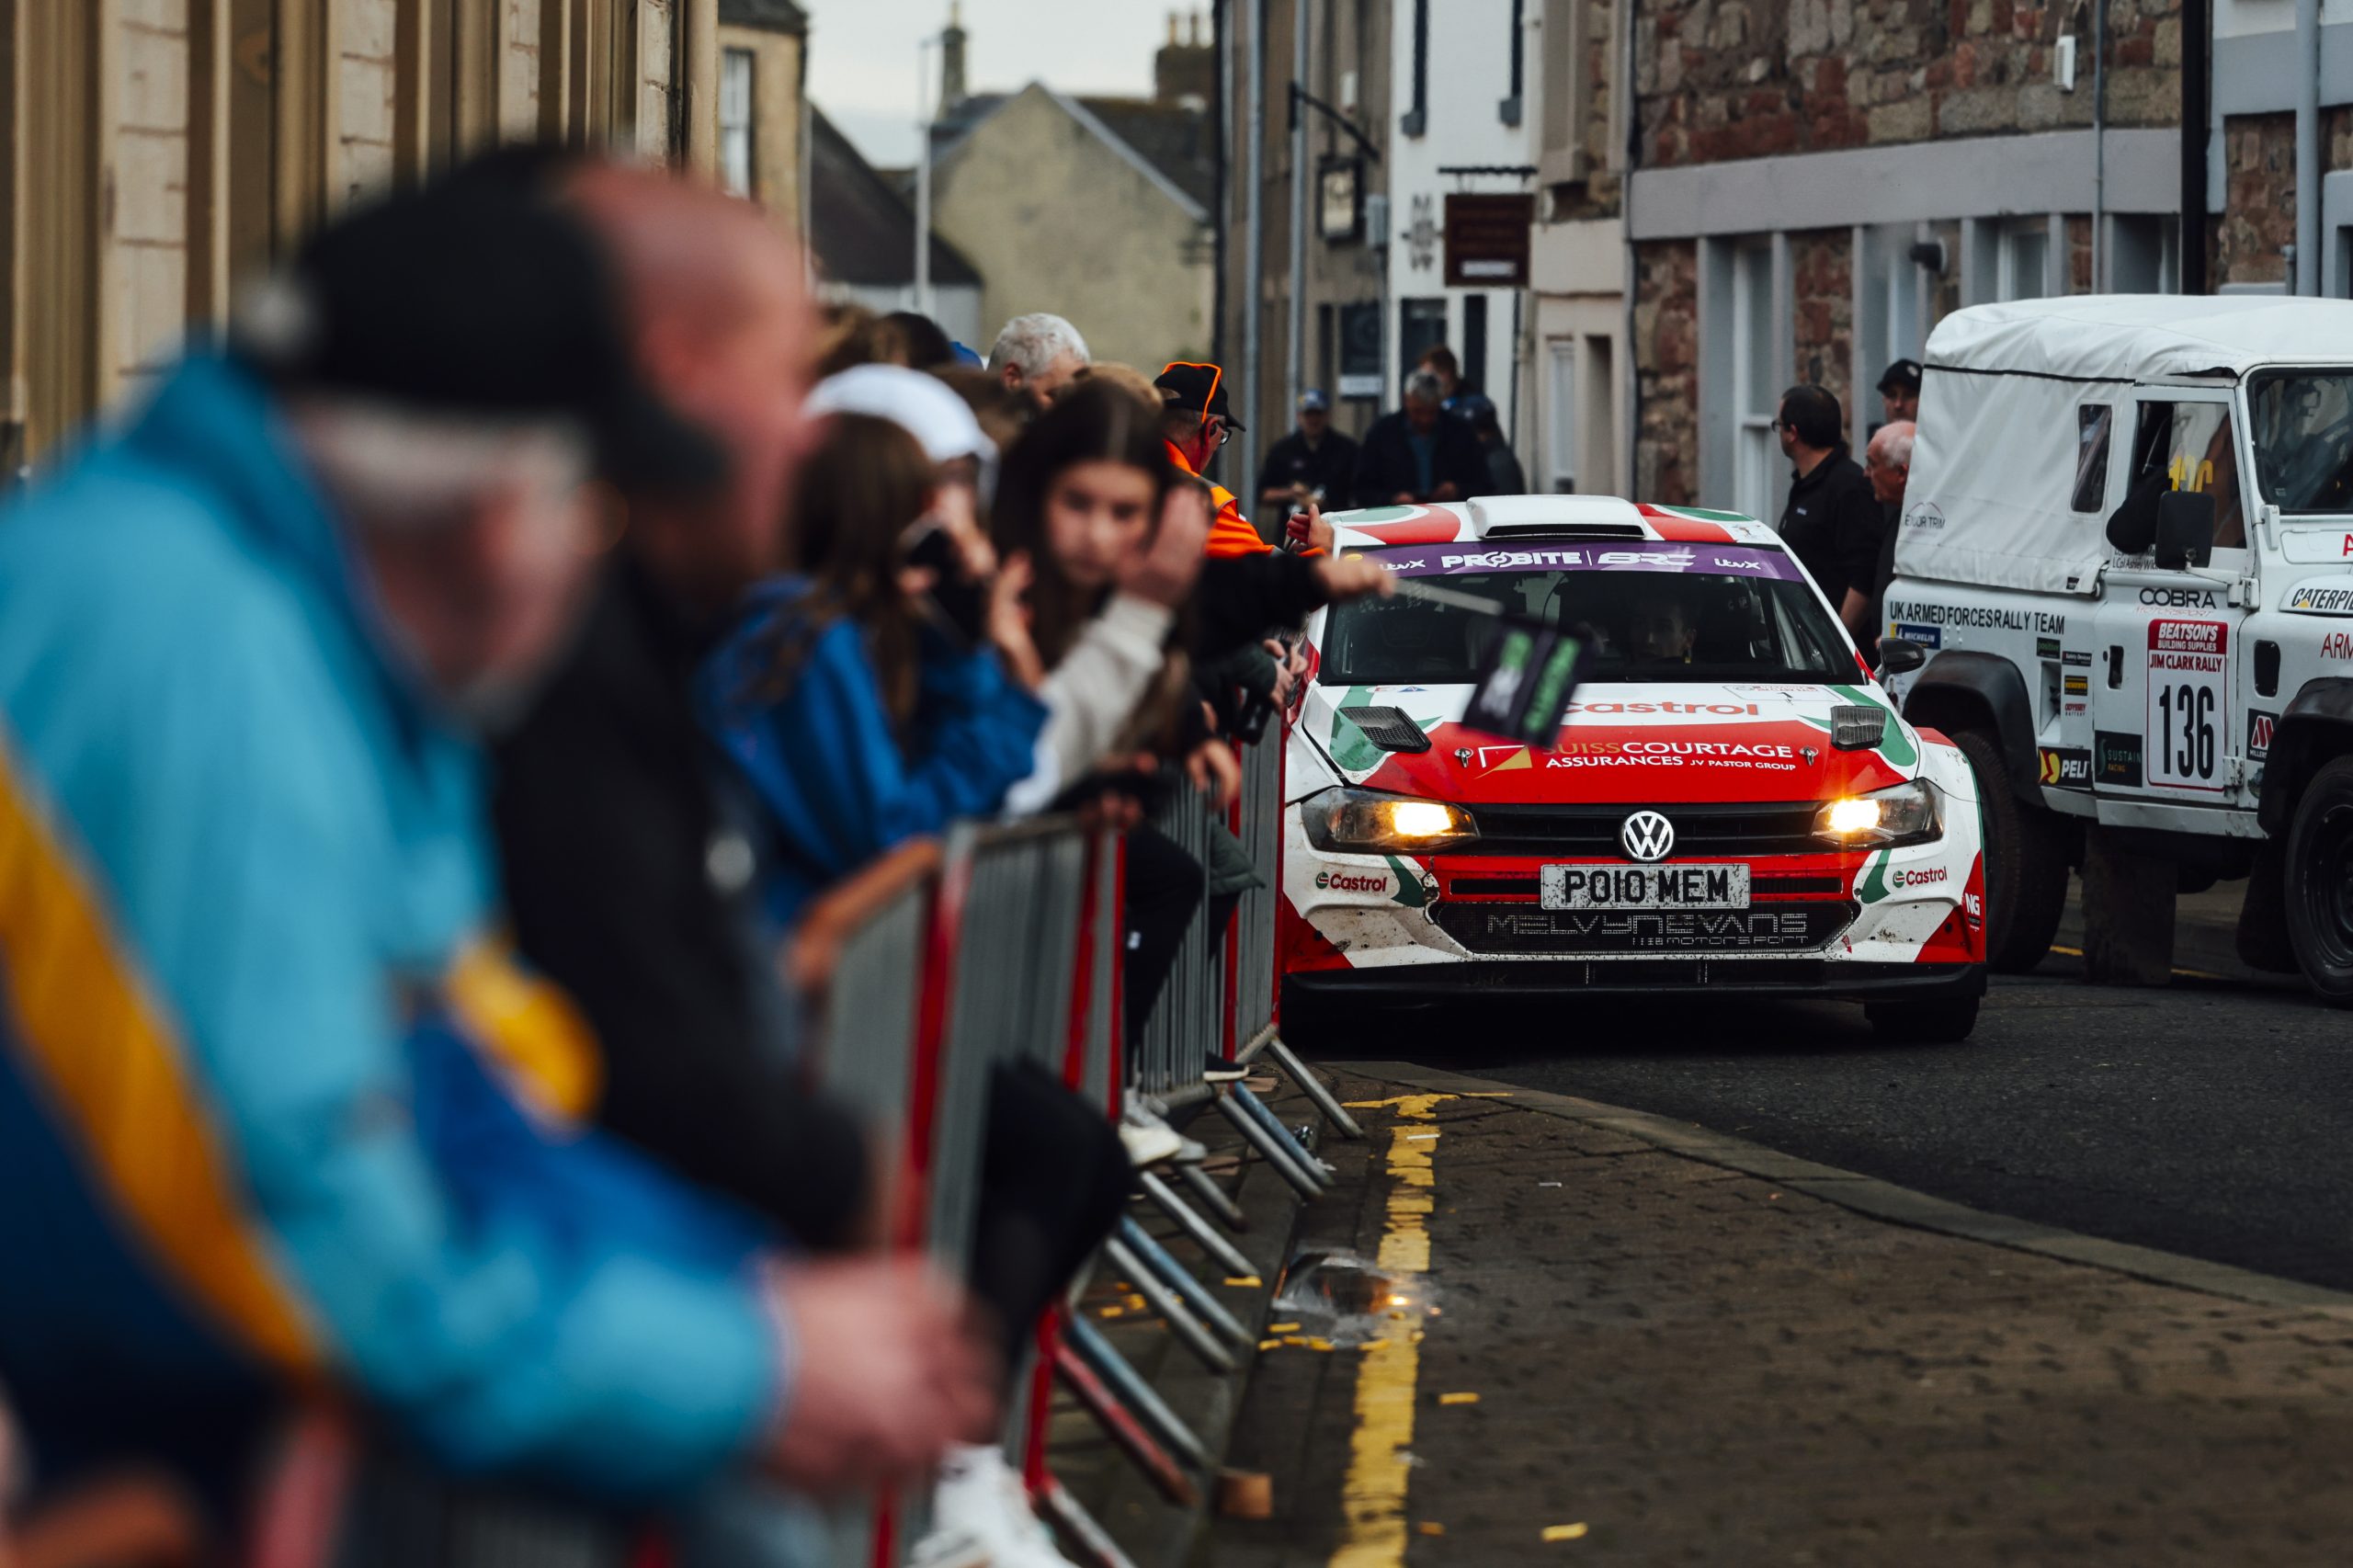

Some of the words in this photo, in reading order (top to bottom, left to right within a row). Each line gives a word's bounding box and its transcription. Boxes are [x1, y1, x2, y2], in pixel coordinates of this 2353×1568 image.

[1441, 551, 1582, 568] PROBITE
[2139, 588, 2217, 609] COBRA
[1890, 601, 1904, 619] UK
[1905, 603, 1946, 624] ARMED
[1947, 607, 1994, 628] FORCES
[1994, 609, 2031, 631] RALLY
[2034, 612, 2065, 634] TEAM
[1904, 631, 1936, 642] MICHELIN
[2158, 622, 2218, 642] BEATSON'S
[2157, 639, 2187, 651] BUILDING
[2188, 642, 2217, 653] SUPPLIES
[2150, 654, 2165, 669] JIM
[2166, 654, 2194, 671] CLARK
[2195, 656, 2222, 672] RALLY
[2159, 684, 2214, 779] 136
[1546, 756, 1684, 768] ASSURANCES
[1709, 760, 1752, 768] PASTOR
[1755, 762, 1796, 771] GROUP
[2108, 748, 2142, 763] SUSTAIN
[2061, 760, 2087, 778] PELI
[2108, 763, 2125, 772] RACING
[1330, 873, 1387, 892] Castrol
[1906, 866, 1947, 885] Castrol
[1658, 869, 1729, 903] MEM
[1965, 892, 1981, 915] NG
